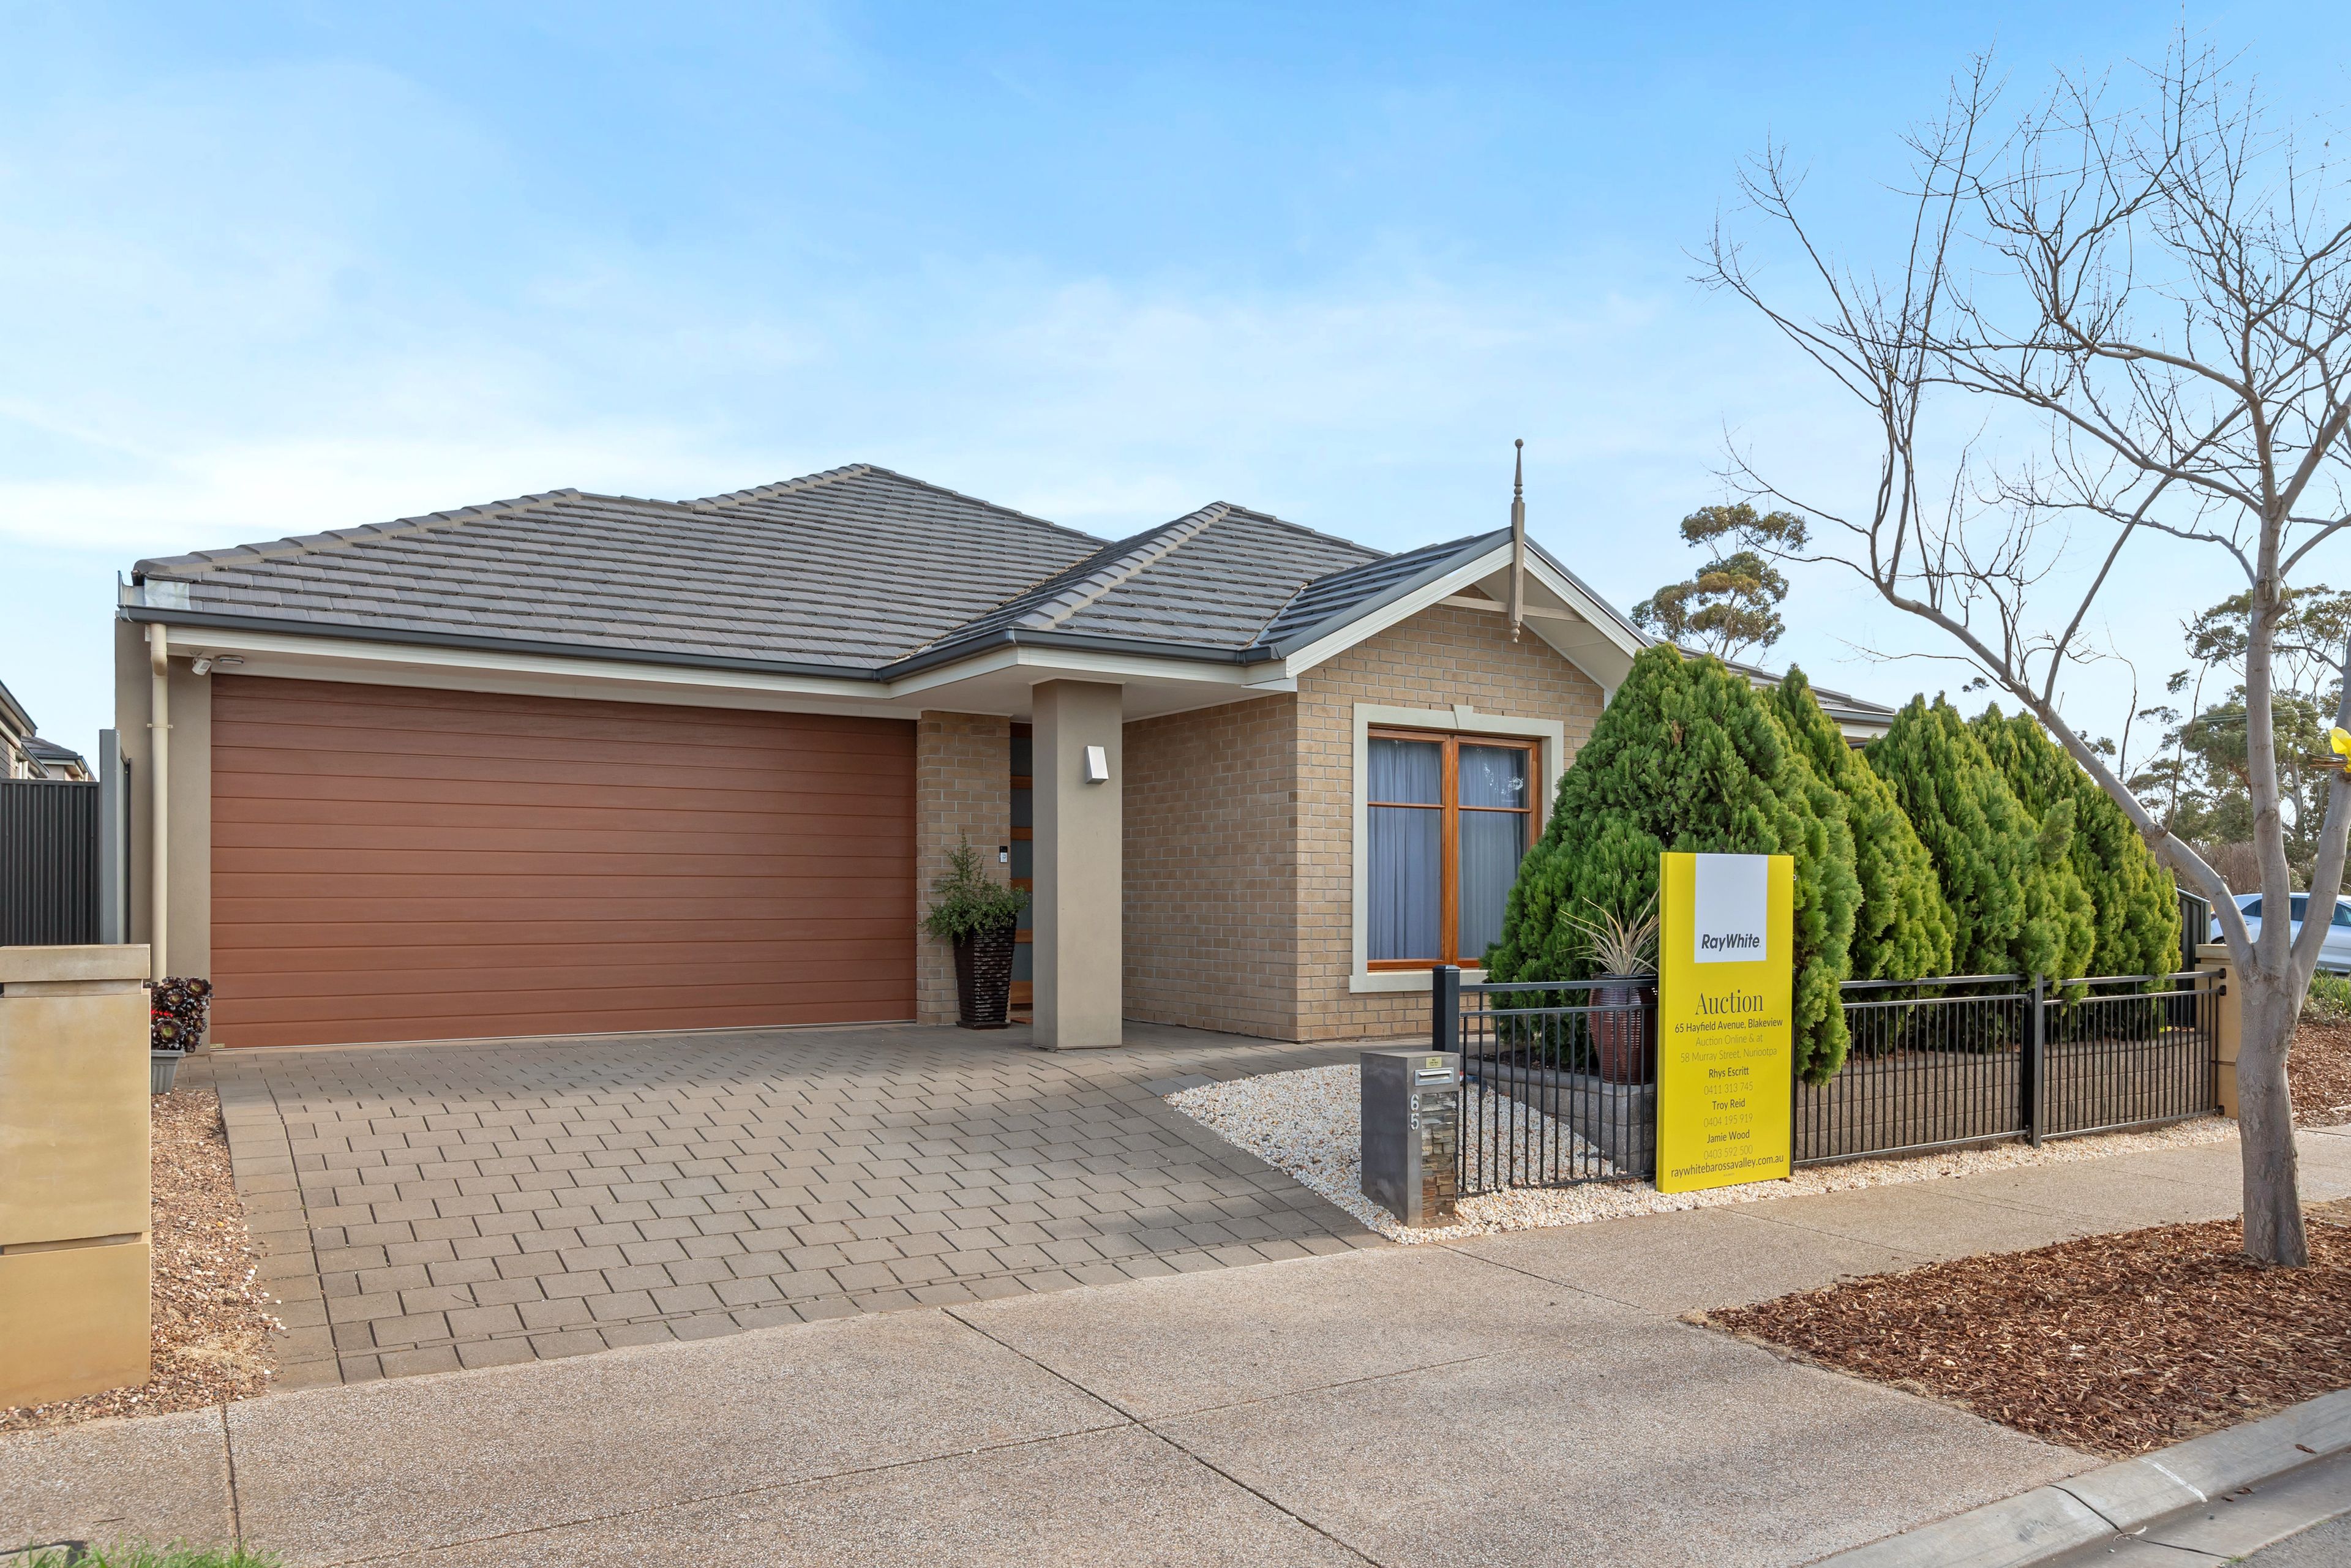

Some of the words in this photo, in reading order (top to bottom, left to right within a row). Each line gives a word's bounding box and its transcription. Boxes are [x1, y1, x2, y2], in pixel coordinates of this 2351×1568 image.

[1701, 934, 1760, 951] RayWhite
[1695, 989, 1763, 1015] Auction
[1675, 1023, 1684, 1033] 65
[1686, 1021, 1715, 1033] Hayfield
[1718, 1021, 1746, 1030] Avenue,
[1748, 1018, 1783, 1029] Blakeview
[1695, 1036, 1723, 1046] Auction
[1725, 1034, 1747, 1045] Online
[1749, 1034, 1755, 1043] &
[1757, 1033, 1763, 1043] at
[1681, 1052, 1690, 1063] 58
[1692, 1051, 1716, 1062] Murray
[1719, 1049, 1741, 1060] Street,
[1743, 1047, 1777, 1058] Nuriootpa
[1709, 1068, 1726, 1079] Rhys
[1728, 1067, 1749, 1076] Escritt
[1704, 1085, 1722, 1095] 0411
[1724, 1083, 1738, 1093] 313
[1740, 1081, 1753, 1091] 745
[1411, 1094, 1419, 1130] 65
[1712, 1100, 1728, 1111] Troy
[1730, 1098, 1745, 1108] Reid
[1704, 1117, 1722, 1128] 0404
[1725, 1114, 1738, 1125] 195
[1740, 1112, 1753, 1123] 919
[1707, 1133, 1727, 1144] Jamie
[1728, 1129, 1750, 1140] Wood
[1704, 1149, 1722, 1160] 0403
[1724, 1147, 1737, 1157] 592
[1740, 1144, 1753, 1155] 500
[1671, 1155, 1784, 1178] raywhitebarossavalley.com.au
